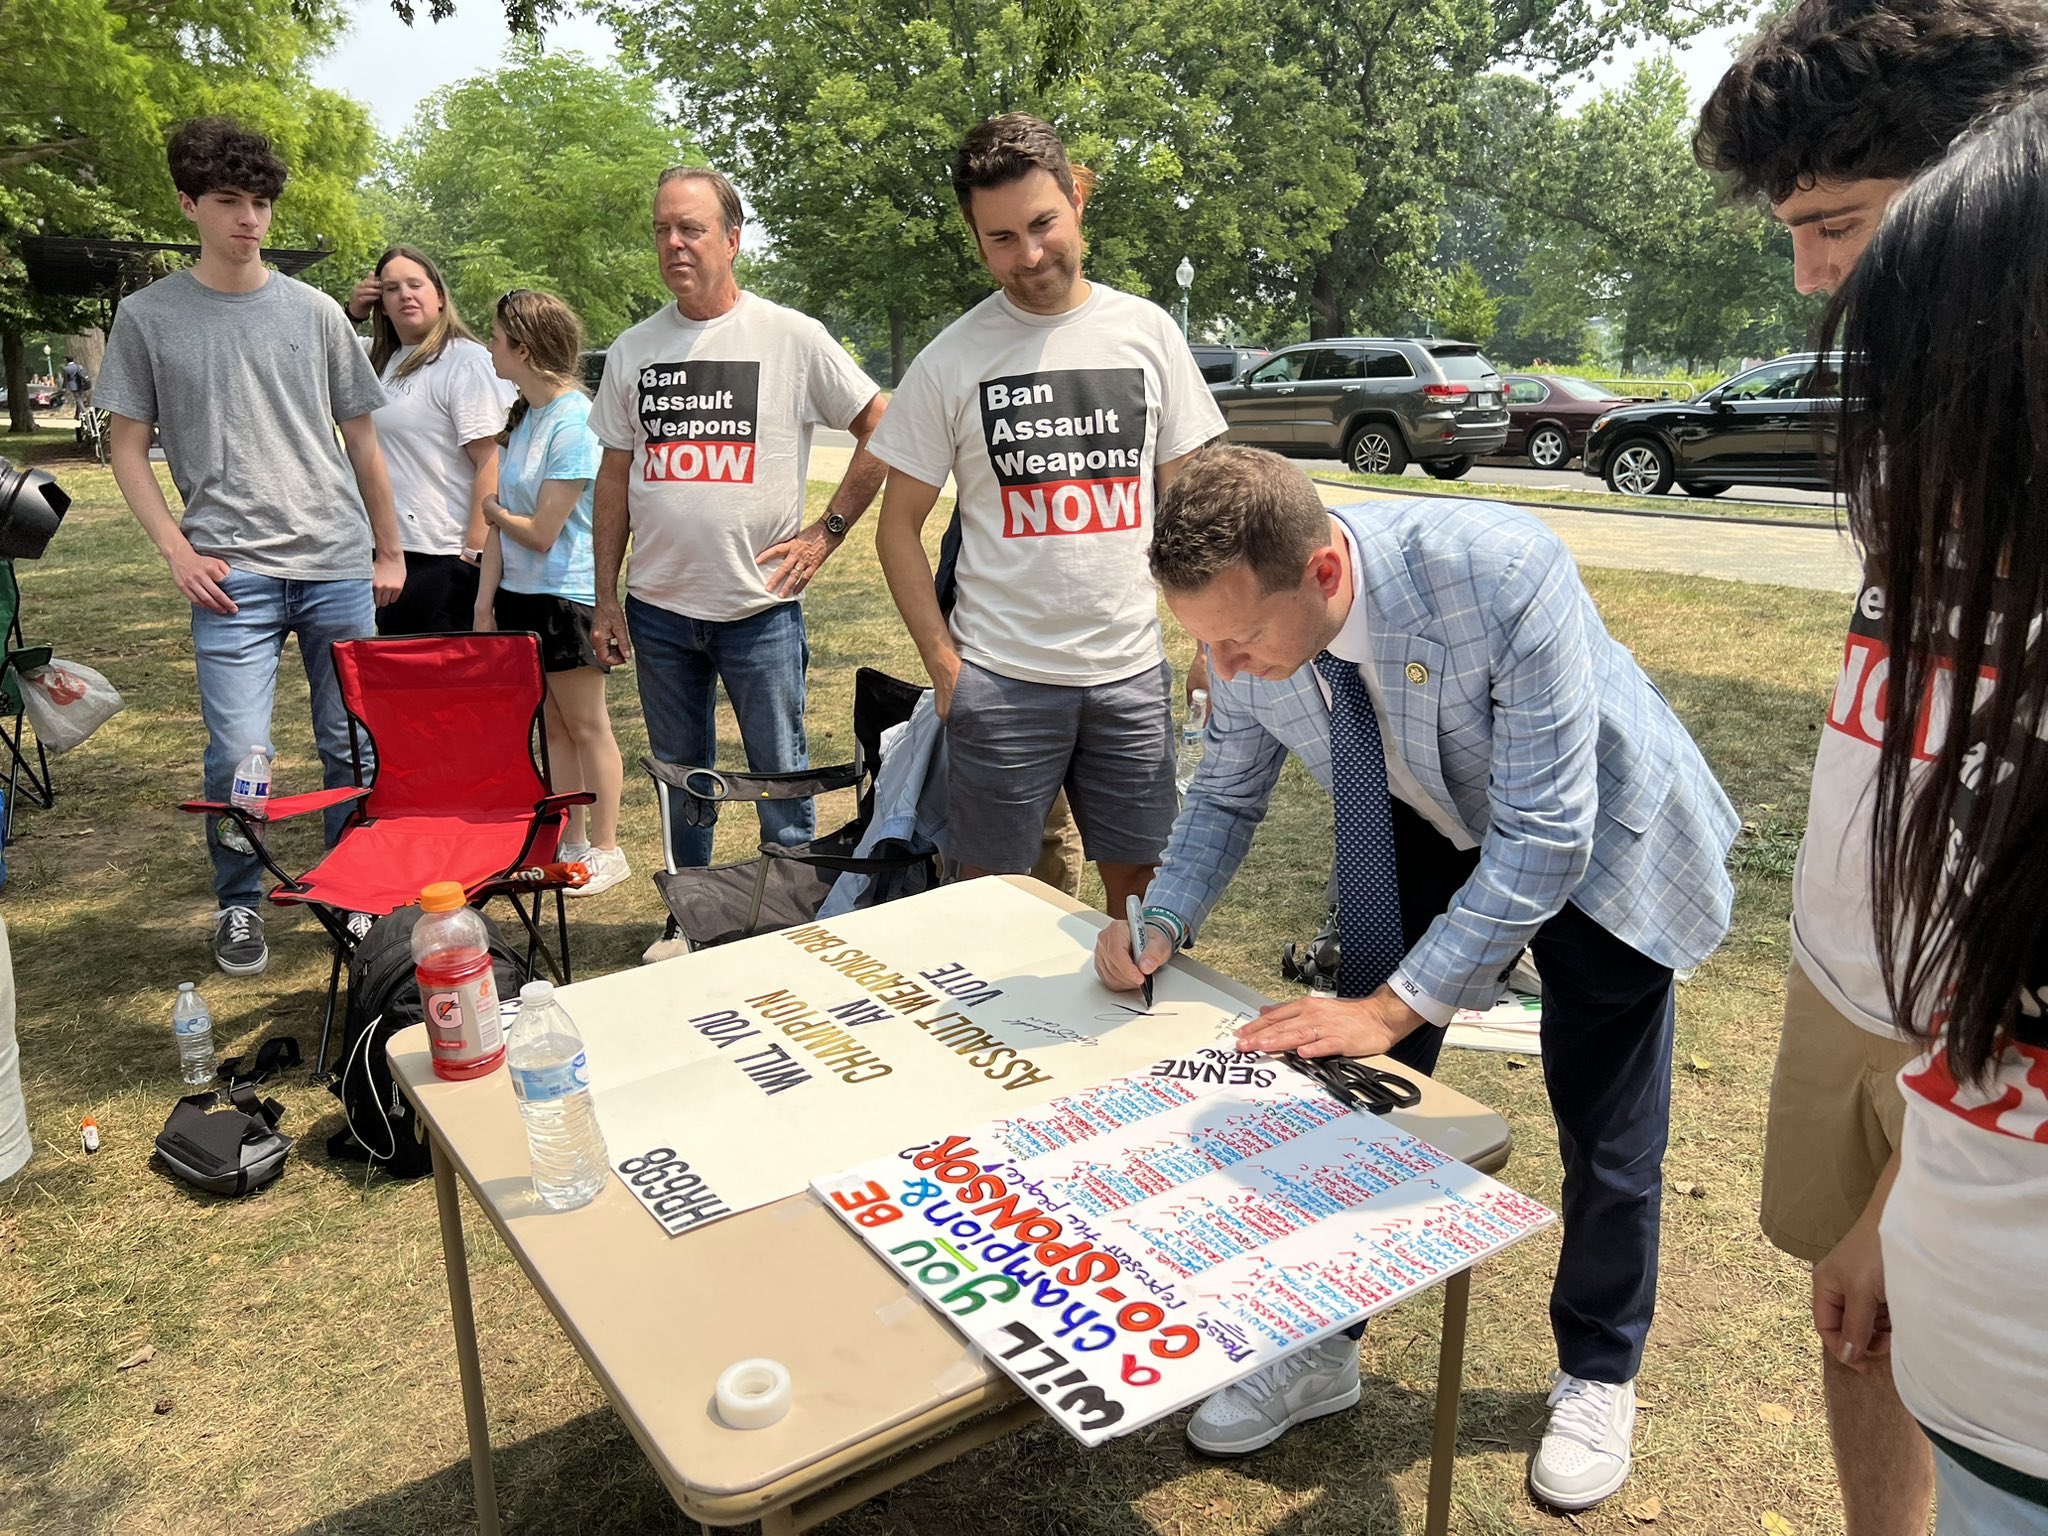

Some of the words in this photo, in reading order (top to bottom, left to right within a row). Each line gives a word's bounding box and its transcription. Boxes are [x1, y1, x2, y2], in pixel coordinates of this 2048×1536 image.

[641, 368, 687, 389] Ban
[986, 383, 1054, 411] Ban
[641, 390, 734, 414] Assault
[643, 417, 752, 440] Weapons
[991, 408, 1120, 446] Assault
[646, 444, 752, 481] NOW
[994, 447, 1139, 477] Weapons
[1008, 481, 1138, 535] NOW
[779, 923, 848, 954] BAN
[818, 948, 941, 1016] WEAPONS
[917, 961, 1004, 1008] VOTE
[686, 1009, 762, 1049] YOU
[825, 997, 896, 1027] AN
[742, 987, 893, 1084] CHAMPION
[911, 1010, 1054, 1091] ASSAULT
[732, 1041, 813, 1096] WILL
[1148, 1058, 1277, 1089] SENATE
[617, 1146, 731, 1231] HR698
[828, 1179, 904, 1228] BE
[898, 1176, 943, 1207] &
[1050, 1212, 1102, 1247] the
[922, 1198, 1117, 1352] Champion
[1101, 1243, 1188, 1310] represent
[1248, 1295, 1305, 1340] BARRASSO,
[1262, 1278, 1331, 1328] BLACKBURN,
[1266, 1295, 1319, 1335] BENNET,
[1119, 1352, 1162, 1387] a
